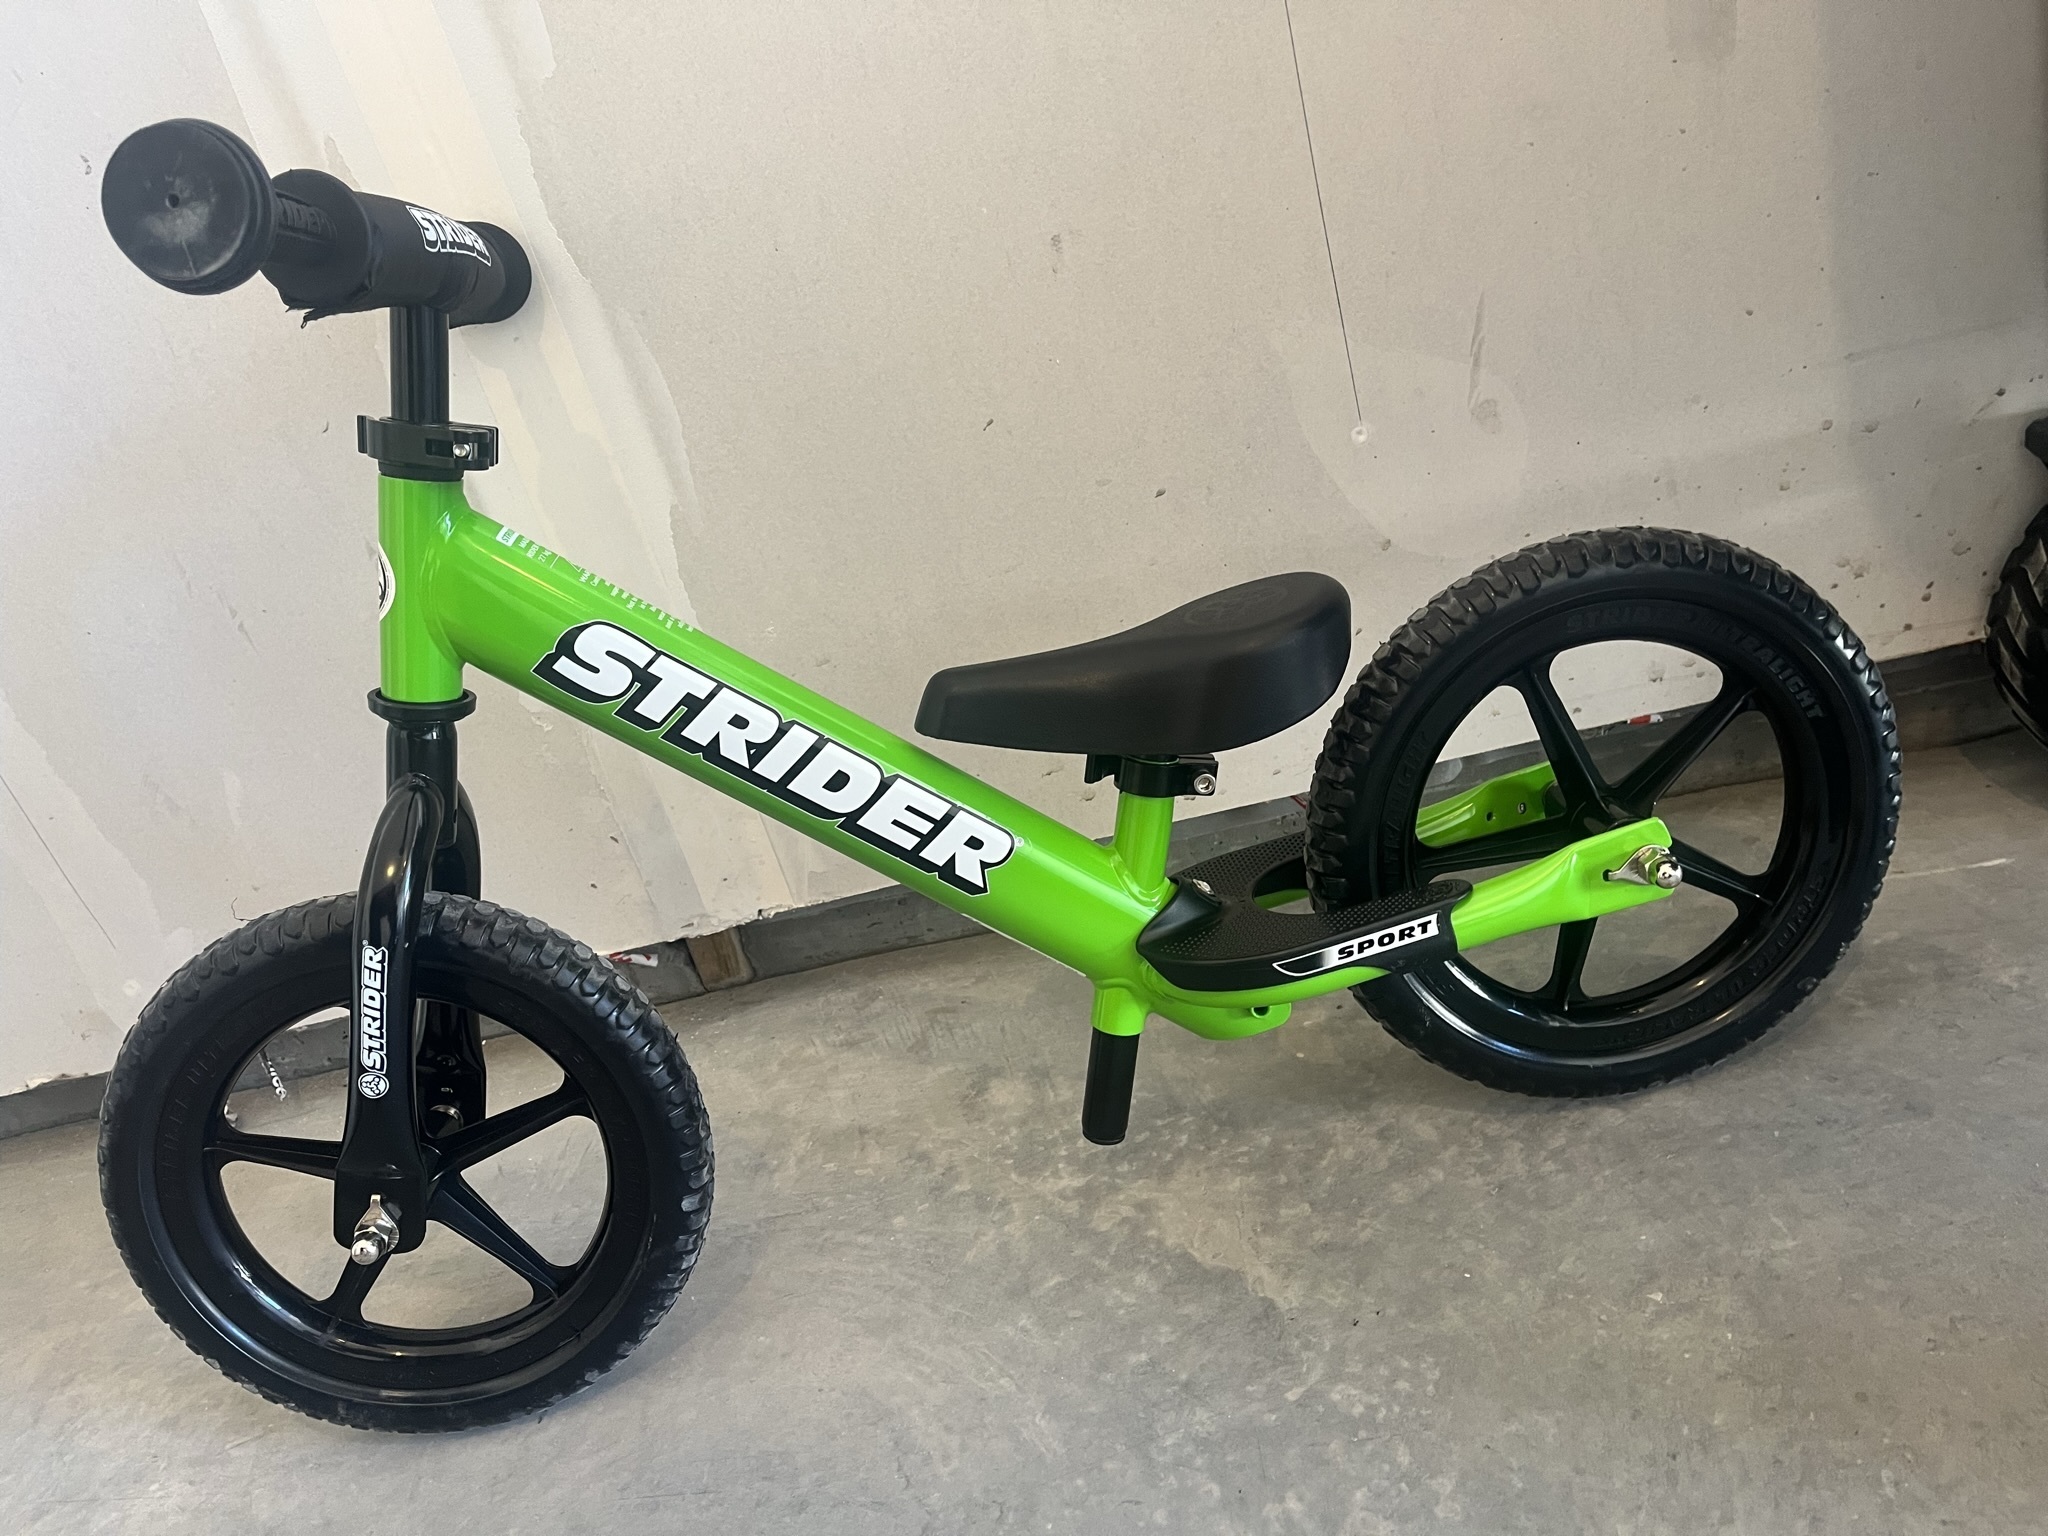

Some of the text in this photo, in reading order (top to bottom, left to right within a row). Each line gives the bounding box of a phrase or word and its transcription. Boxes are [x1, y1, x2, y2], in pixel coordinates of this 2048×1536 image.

[406, 206, 491, 266] STRIDER
[533, 620, 1016, 894] STRIDER
[1338, 919, 1433, 961] SPORT
[361, 945, 388, 1074] STRIDER
